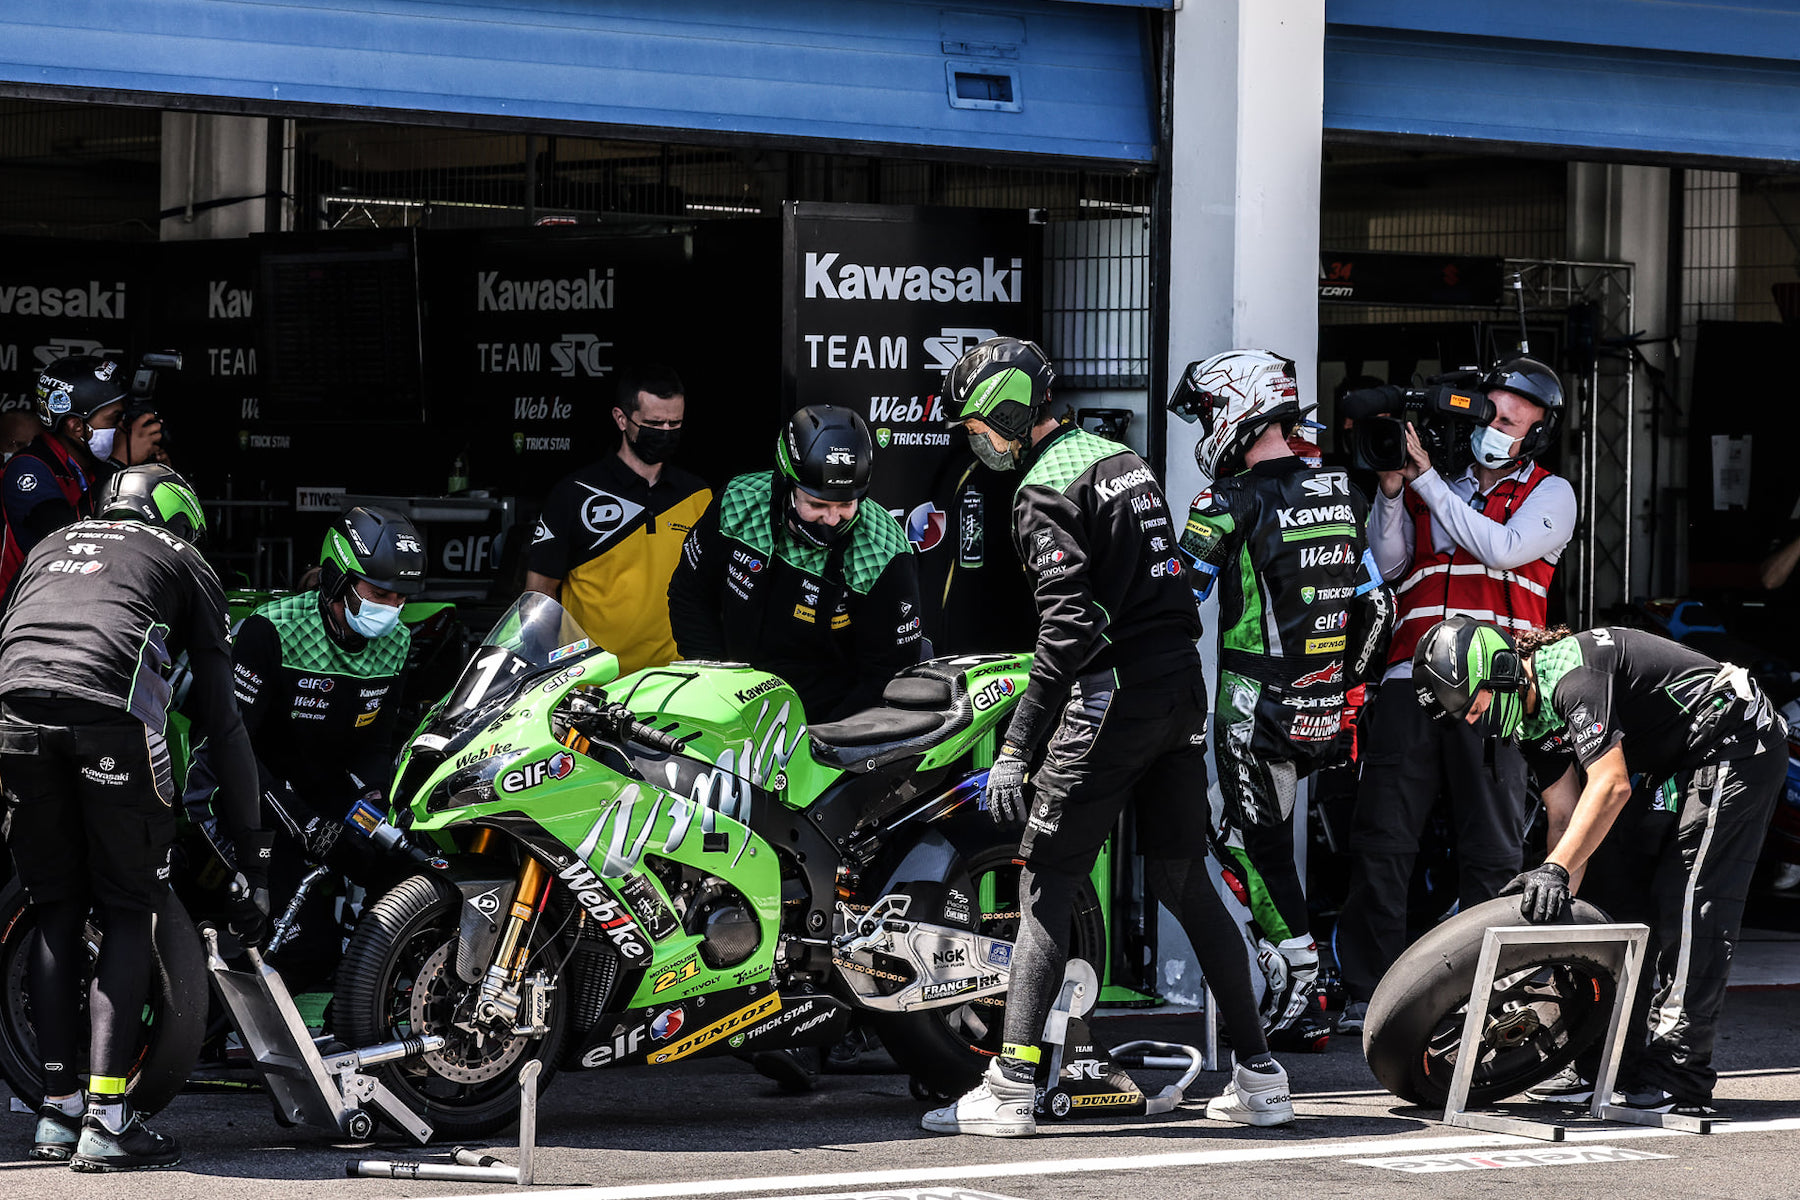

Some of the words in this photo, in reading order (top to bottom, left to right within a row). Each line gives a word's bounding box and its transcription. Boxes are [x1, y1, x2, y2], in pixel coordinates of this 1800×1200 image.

[804, 252, 1022, 303] Kawasaki
[1329, 261, 1353, 280] 34
[477, 268, 614, 311] Kawasaki
[477, 342, 541, 373] TEAM
[550, 333, 613, 377] SRC
[804, 334, 908, 370] TEAM
[974, 375, 1001, 408] Kawasaki
[525, 436, 550, 451] TRICK
[550, 437, 571, 451] STAR
[893, 432, 923, 446] TRICK
[924, 433, 950, 446] STAR
[826, 452, 856, 465] SRC
[1150, 536, 1168, 552] SRC
[442, 535, 490, 572] elf
[732, 550, 752, 565] elf
[1037, 552, 1052, 567] elf
[48, 560, 82, 574] elf
[1150, 562, 1166, 578] elf
[1317, 588, 1341, 600] TRICK
[896, 620, 914, 634] elf
[1314, 612, 1338, 630] elf
[298, 678, 320, 690] elf
[464, 651, 508, 710] 1
[510, 656, 528, 675] T
[542, 674, 570, 692] elf
[974, 682, 1000, 710] elf
[1576, 729, 1592, 743] elf
[80, 766, 130, 782] Kawasaki
[502, 758, 548, 792] elf
[932, 948, 965, 965] NGK
[650, 966, 670, 980] MOTO
[666, 952, 698, 972] HOUSE
[653, 958, 701, 995] 21
[690, 975, 722, 994] TIVOLY
[980, 973, 1001, 988] RK
[924, 979, 968, 995] FRANCE
[674, 998, 774, 1056] DUNLOP
[747, 1018, 783, 1040] TRICK
[783, 1000, 814, 1022] STAR
[580, 1024, 646, 1068] elf
[1074, 1044, 1093, 1053] TEAM
[1066, 1058, 1109, 1080] SRC
[1080, 1092, 1138, 1106] DUNLOP
